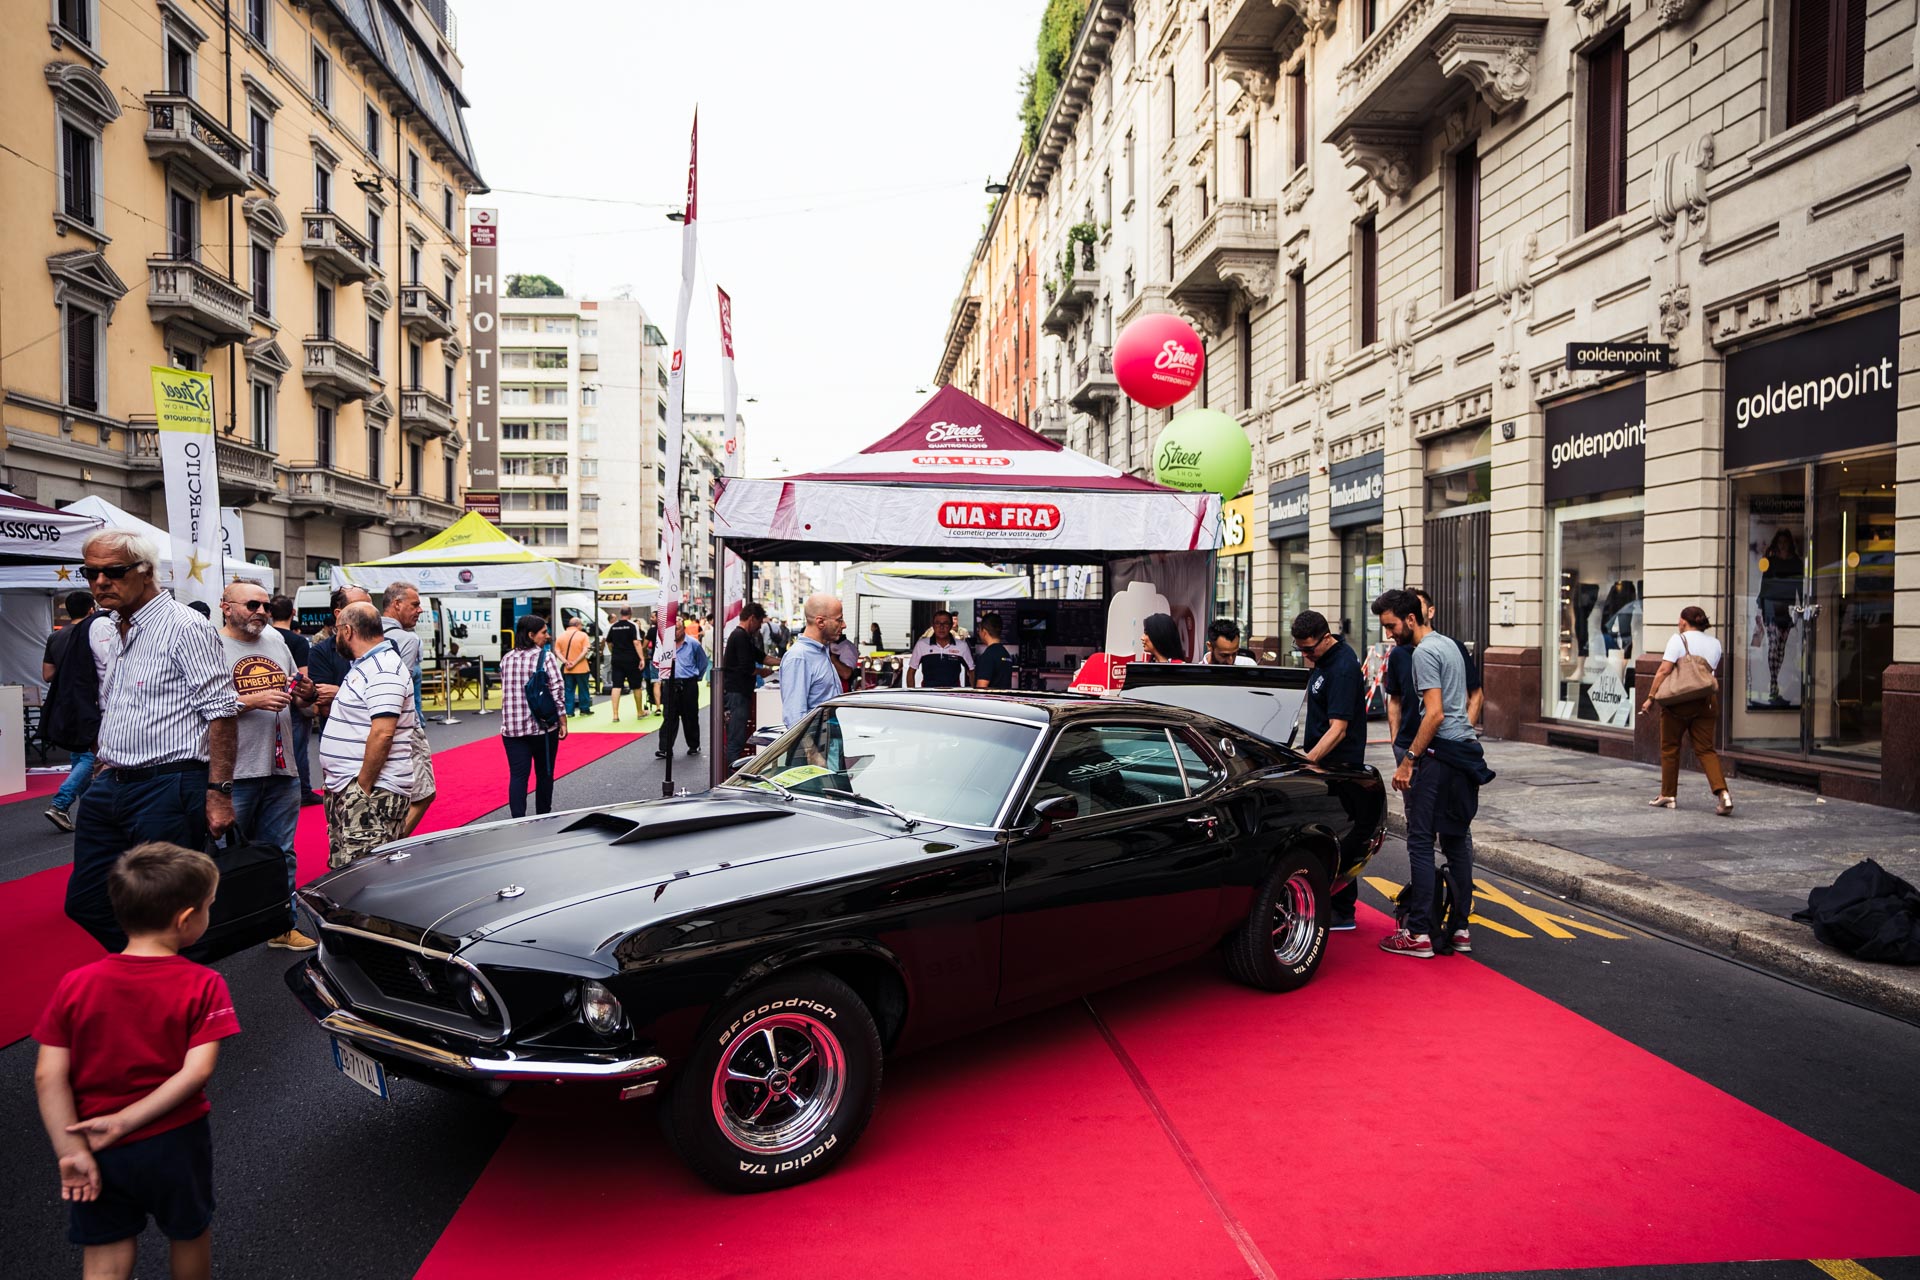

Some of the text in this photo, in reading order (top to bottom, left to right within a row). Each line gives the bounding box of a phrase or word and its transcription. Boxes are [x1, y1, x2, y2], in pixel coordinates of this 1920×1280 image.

[474, 275, 494, 442] HOTEL
[1154, 340, 1198, 369] Street
[1577, 347, 1662, 365] goldenpoint
[1176, 367, 1195, 377] SHOW
[1736, 357, 1893, 429] goldenpoint
[926, 421, 982, 442] Street
[1551, 419, 1647, 469] goldenpoint
[918, 457, 952, 465] MA
[1158, 441, 1202, 471] Street
[1329, 476, 1372, 508] Timberland
[1755, 497, 1807, 510] goldenpoin
[945, 506, 1051, 527] MA FRA
[1268, 495, 1302, 522] Timberland
[597, 593, 628, 601] ZECA
[449, 610, 492, 621] LUTE
[236, 674, 286, 688] TIMBERLAND
[1306, 926, 1325, 967] Radial
[718, 998, 838, 1046] BFGoodrich
[739, 1133, 838, 1175] Radial T/A
